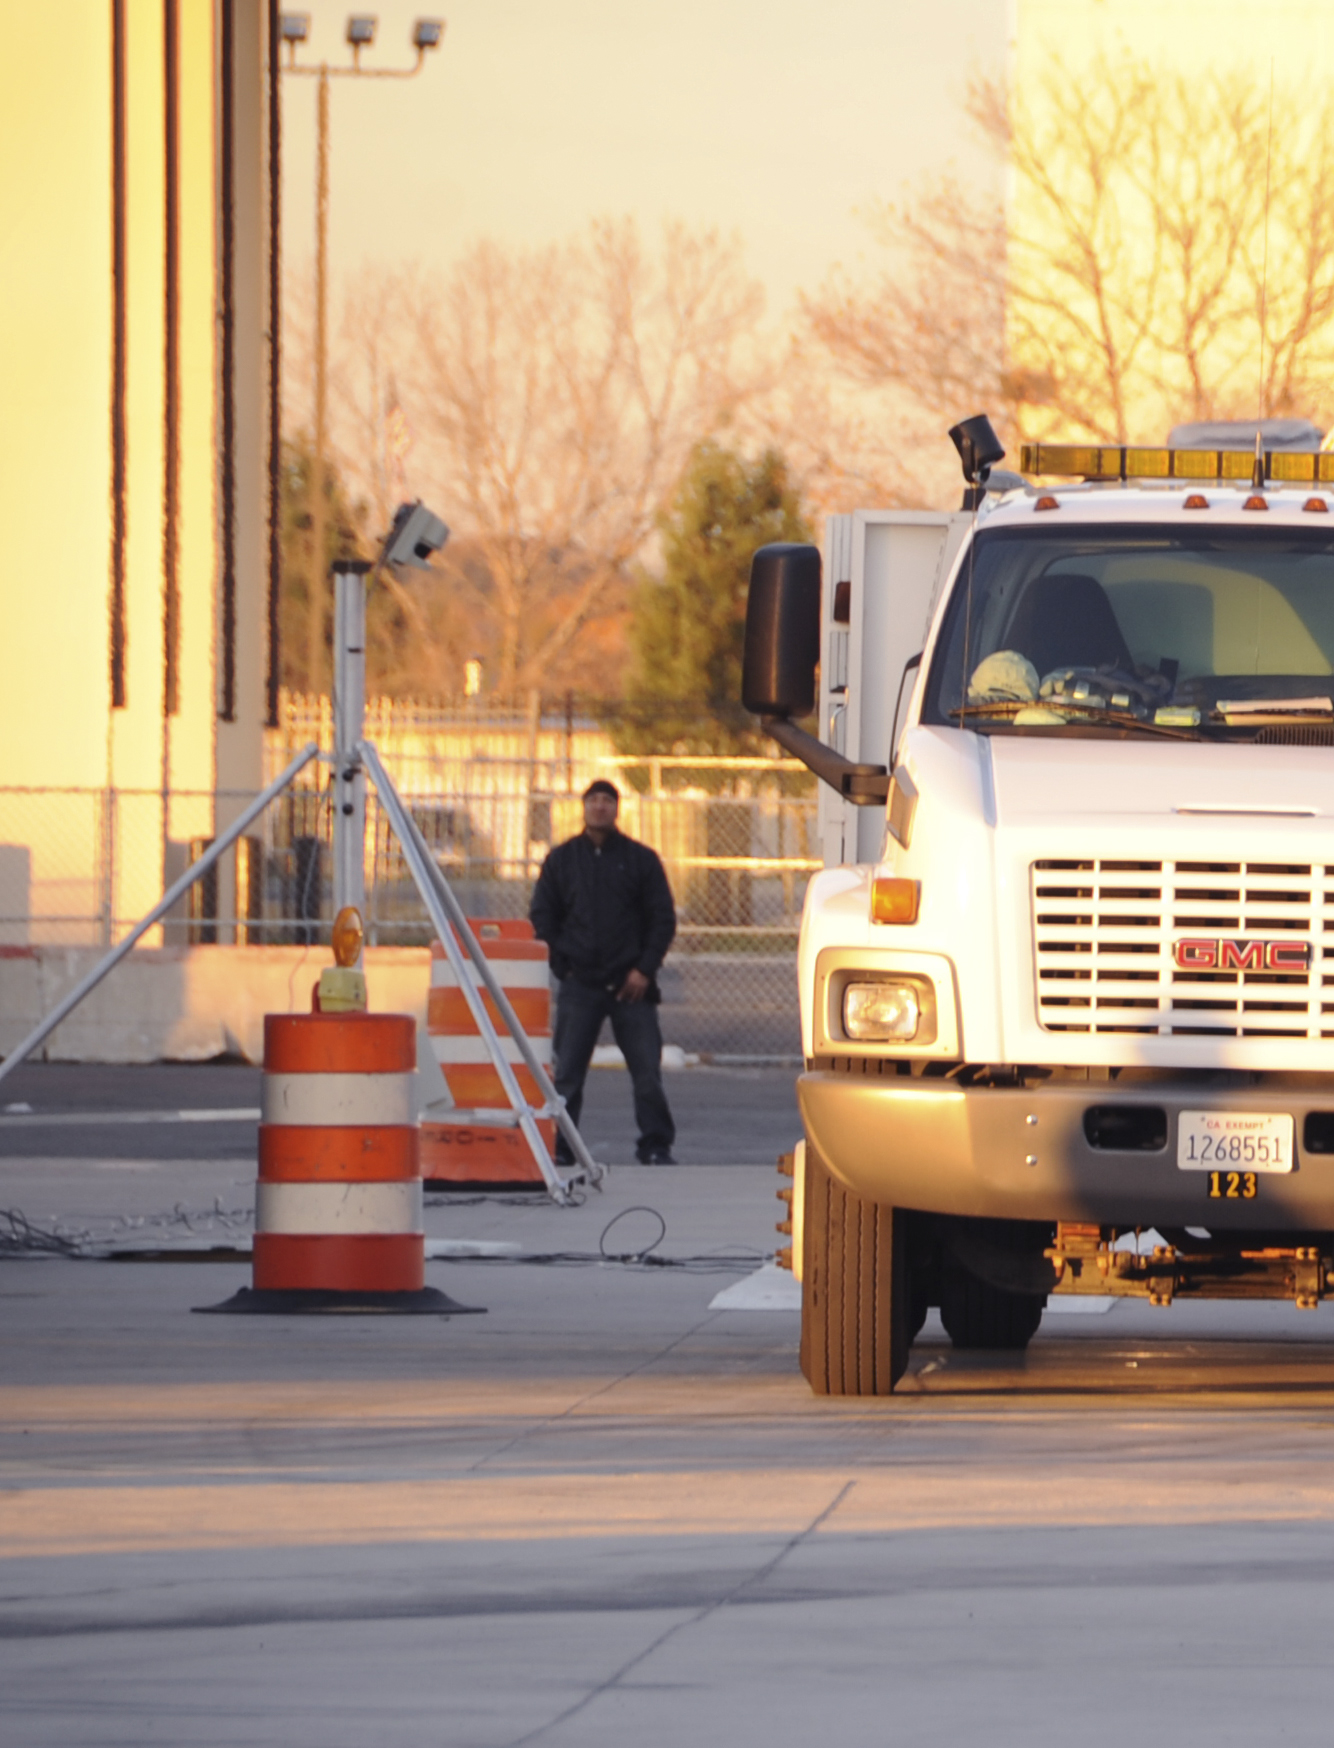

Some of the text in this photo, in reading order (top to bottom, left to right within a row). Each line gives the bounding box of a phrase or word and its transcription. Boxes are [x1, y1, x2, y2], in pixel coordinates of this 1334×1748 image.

[1175, 938, 1309, 970] GMC
[1206, 1120, 1265, 1130] CA EXEMPT
[1186, 1134, 1283, 1163] 1268551
[1209, 1171, 1257, 1198] 123
